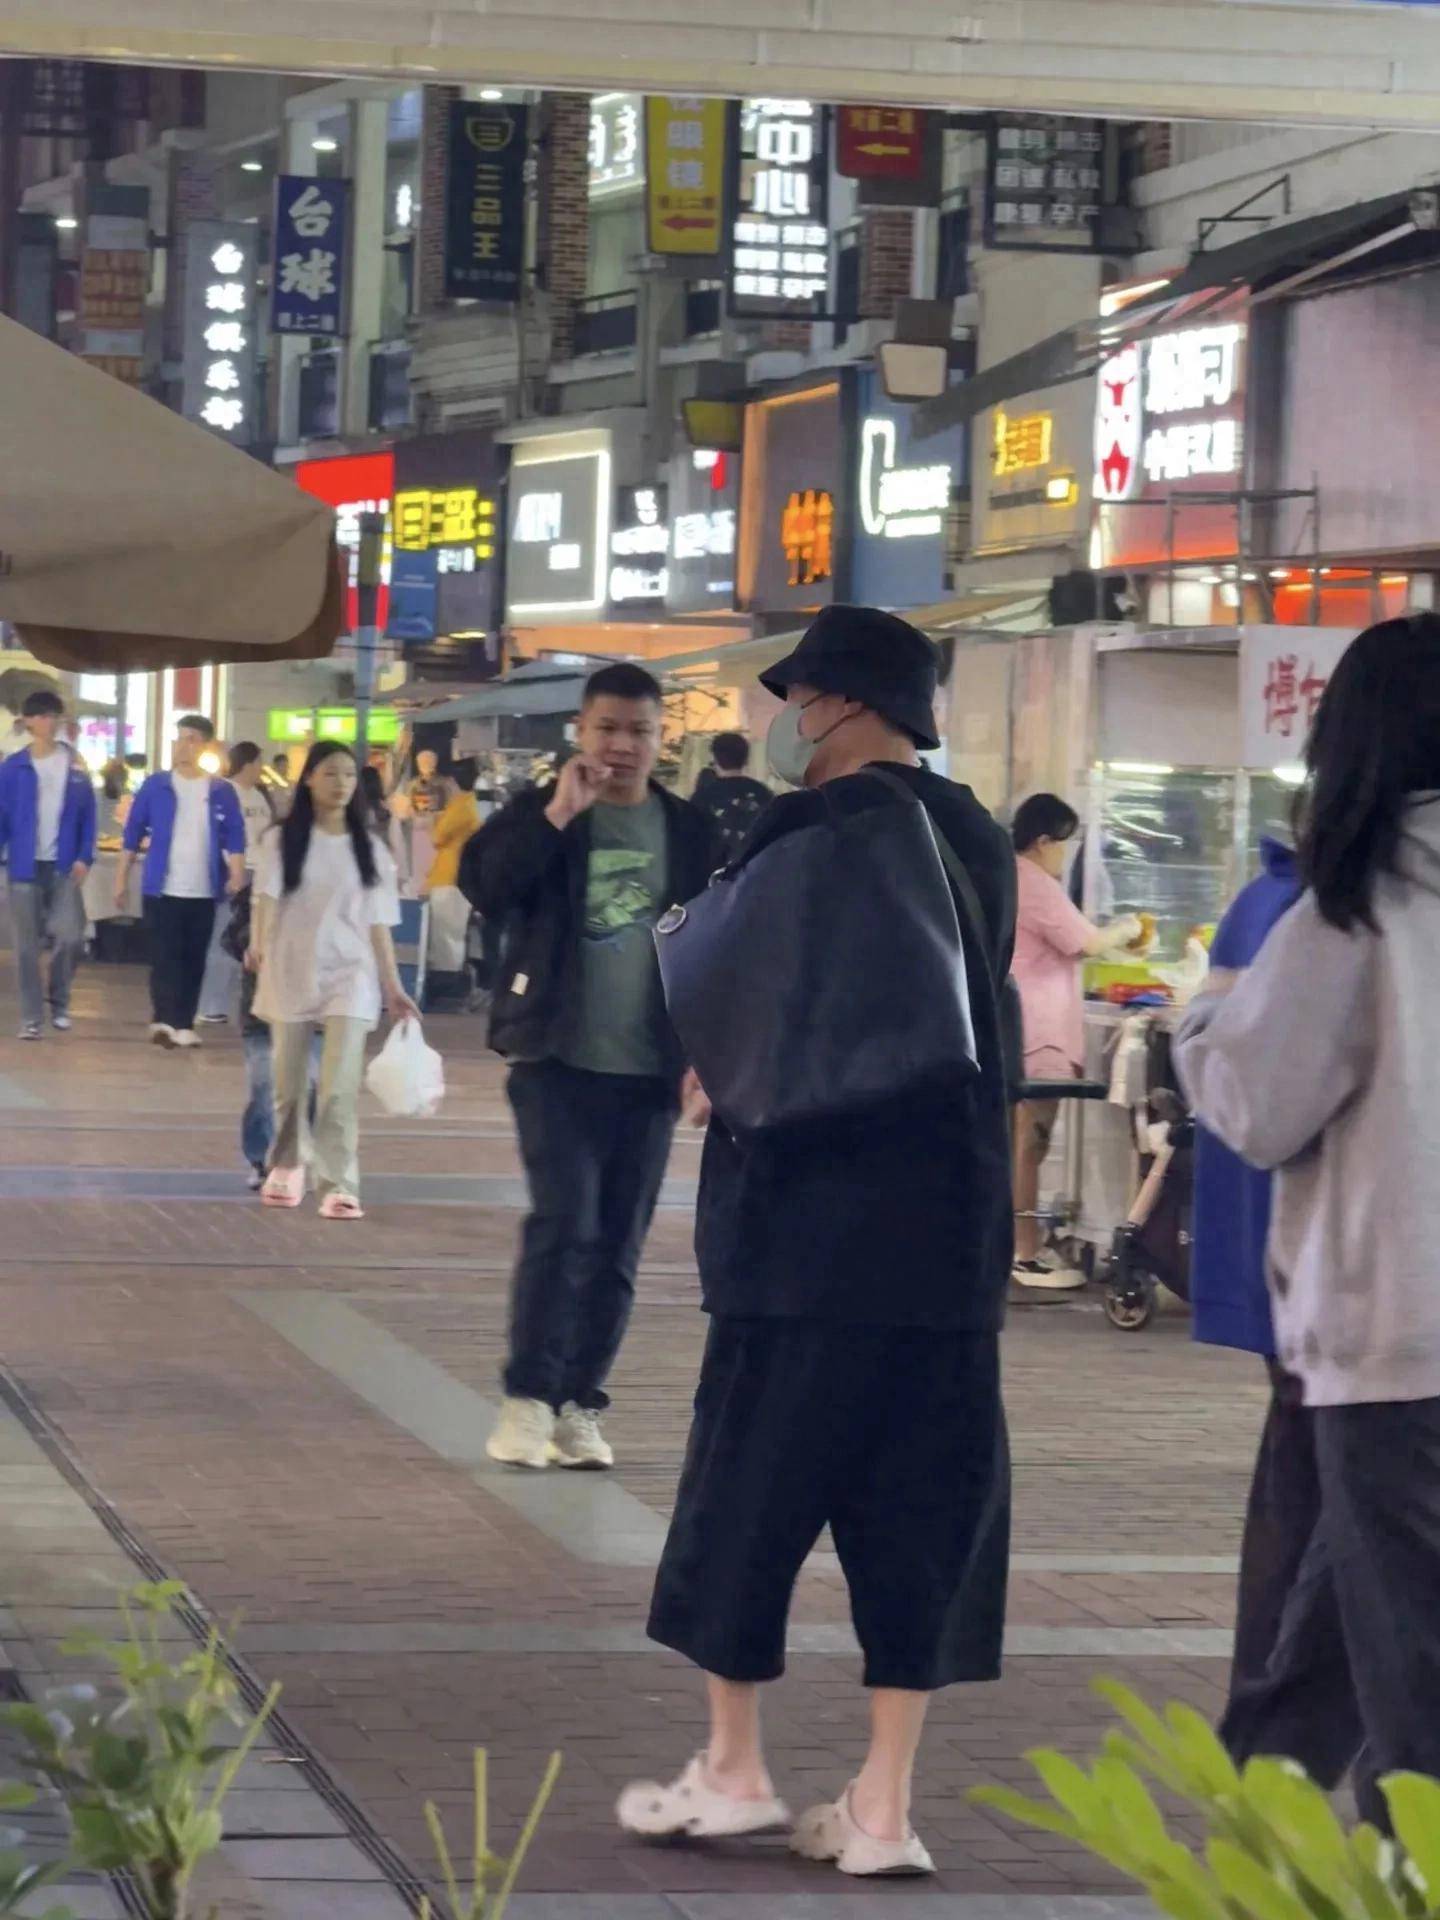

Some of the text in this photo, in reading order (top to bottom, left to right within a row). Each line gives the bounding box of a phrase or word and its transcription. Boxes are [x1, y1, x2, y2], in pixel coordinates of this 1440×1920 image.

[278, 185, 336, 301] 台球
[472, 163, 504, 259] 三品王
